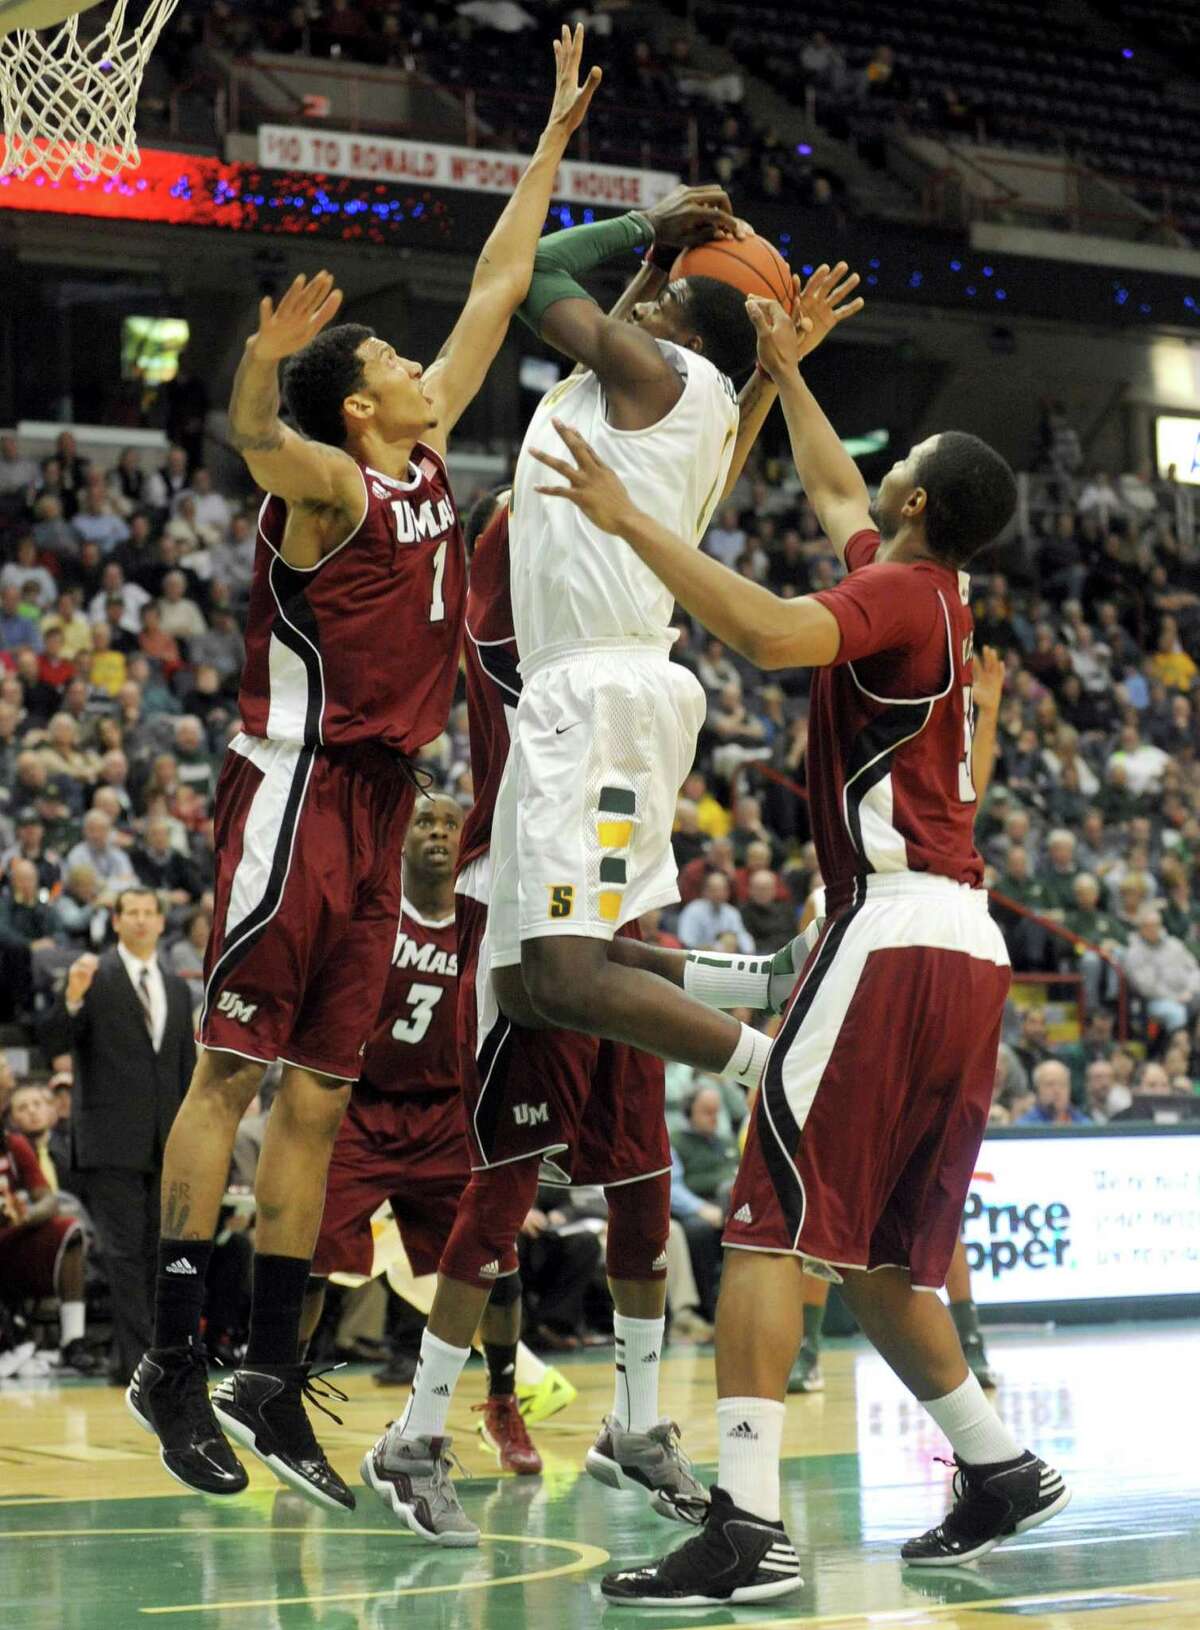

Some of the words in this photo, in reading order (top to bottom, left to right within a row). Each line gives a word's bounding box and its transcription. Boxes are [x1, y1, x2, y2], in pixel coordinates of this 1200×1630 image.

[312, 139, 341, 168] TO
[351, 143, 437, 178] RONALD
[573, 169, 641, 203] HOUSE
[430, 541, 447, 621] 1
[547, 882, 576, 920] S
[217, 990, 258, 1022] UM
[392, 983, 443, 1044] 3
[513, 1102, 549, 1125] UM
